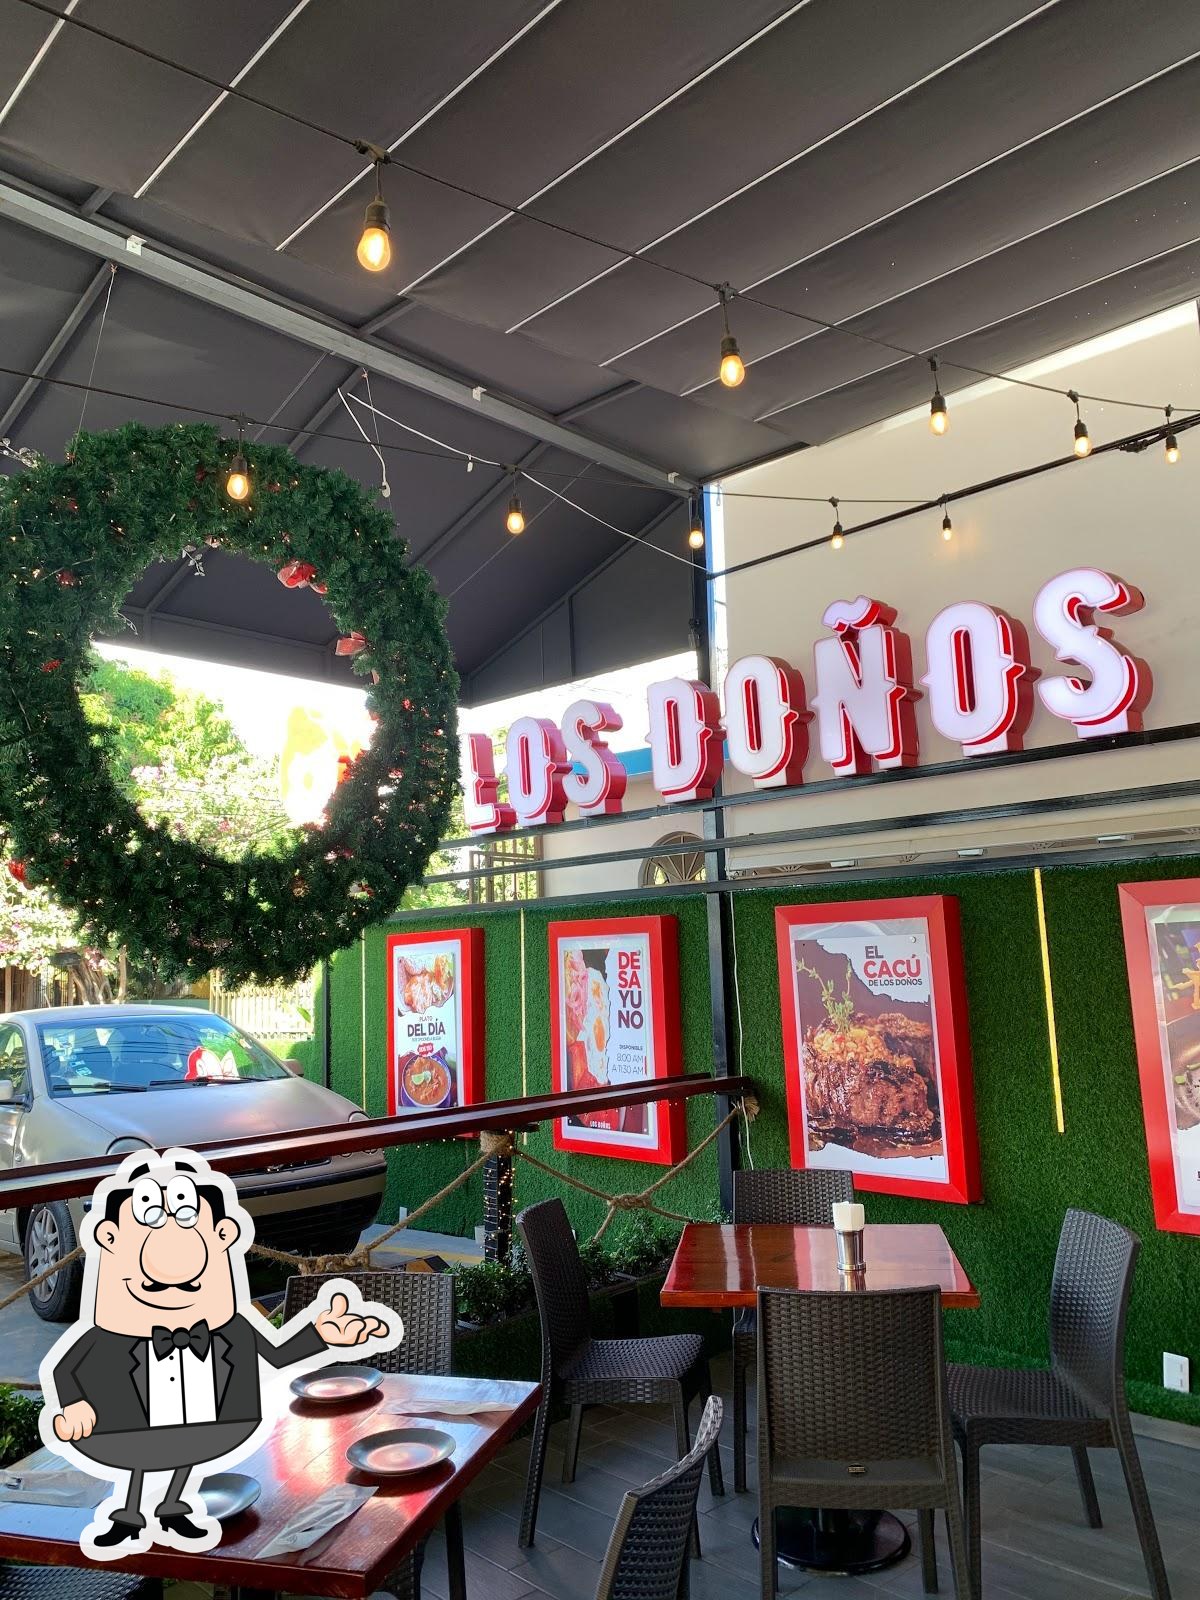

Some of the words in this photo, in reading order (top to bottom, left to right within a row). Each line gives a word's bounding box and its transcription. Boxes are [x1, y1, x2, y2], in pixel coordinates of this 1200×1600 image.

[461, 699, 627, 834] LOS
[645, 568, 1152, 803] DOÑOS
[618, 951, 641, 970] DE
[864, 945, 884, 959] EL
[863, 954, 921, 979] CACÚ
[618, 970, 641, 989] SA
[868, 979, 879, 987] DE
[879, 979, 894, 987] LOS
[895, 977, 923, 986] DOÑOS
[618, 989, 642, 1009] YU
[407, 1023, 426, 1037] DEL
[428, 1018, 446, 1036] DÍA
[618, 1010, 644, 1030] NO
[632, 1055, 643, 1064] AM
[632, 1066, 643, 1075] AM
